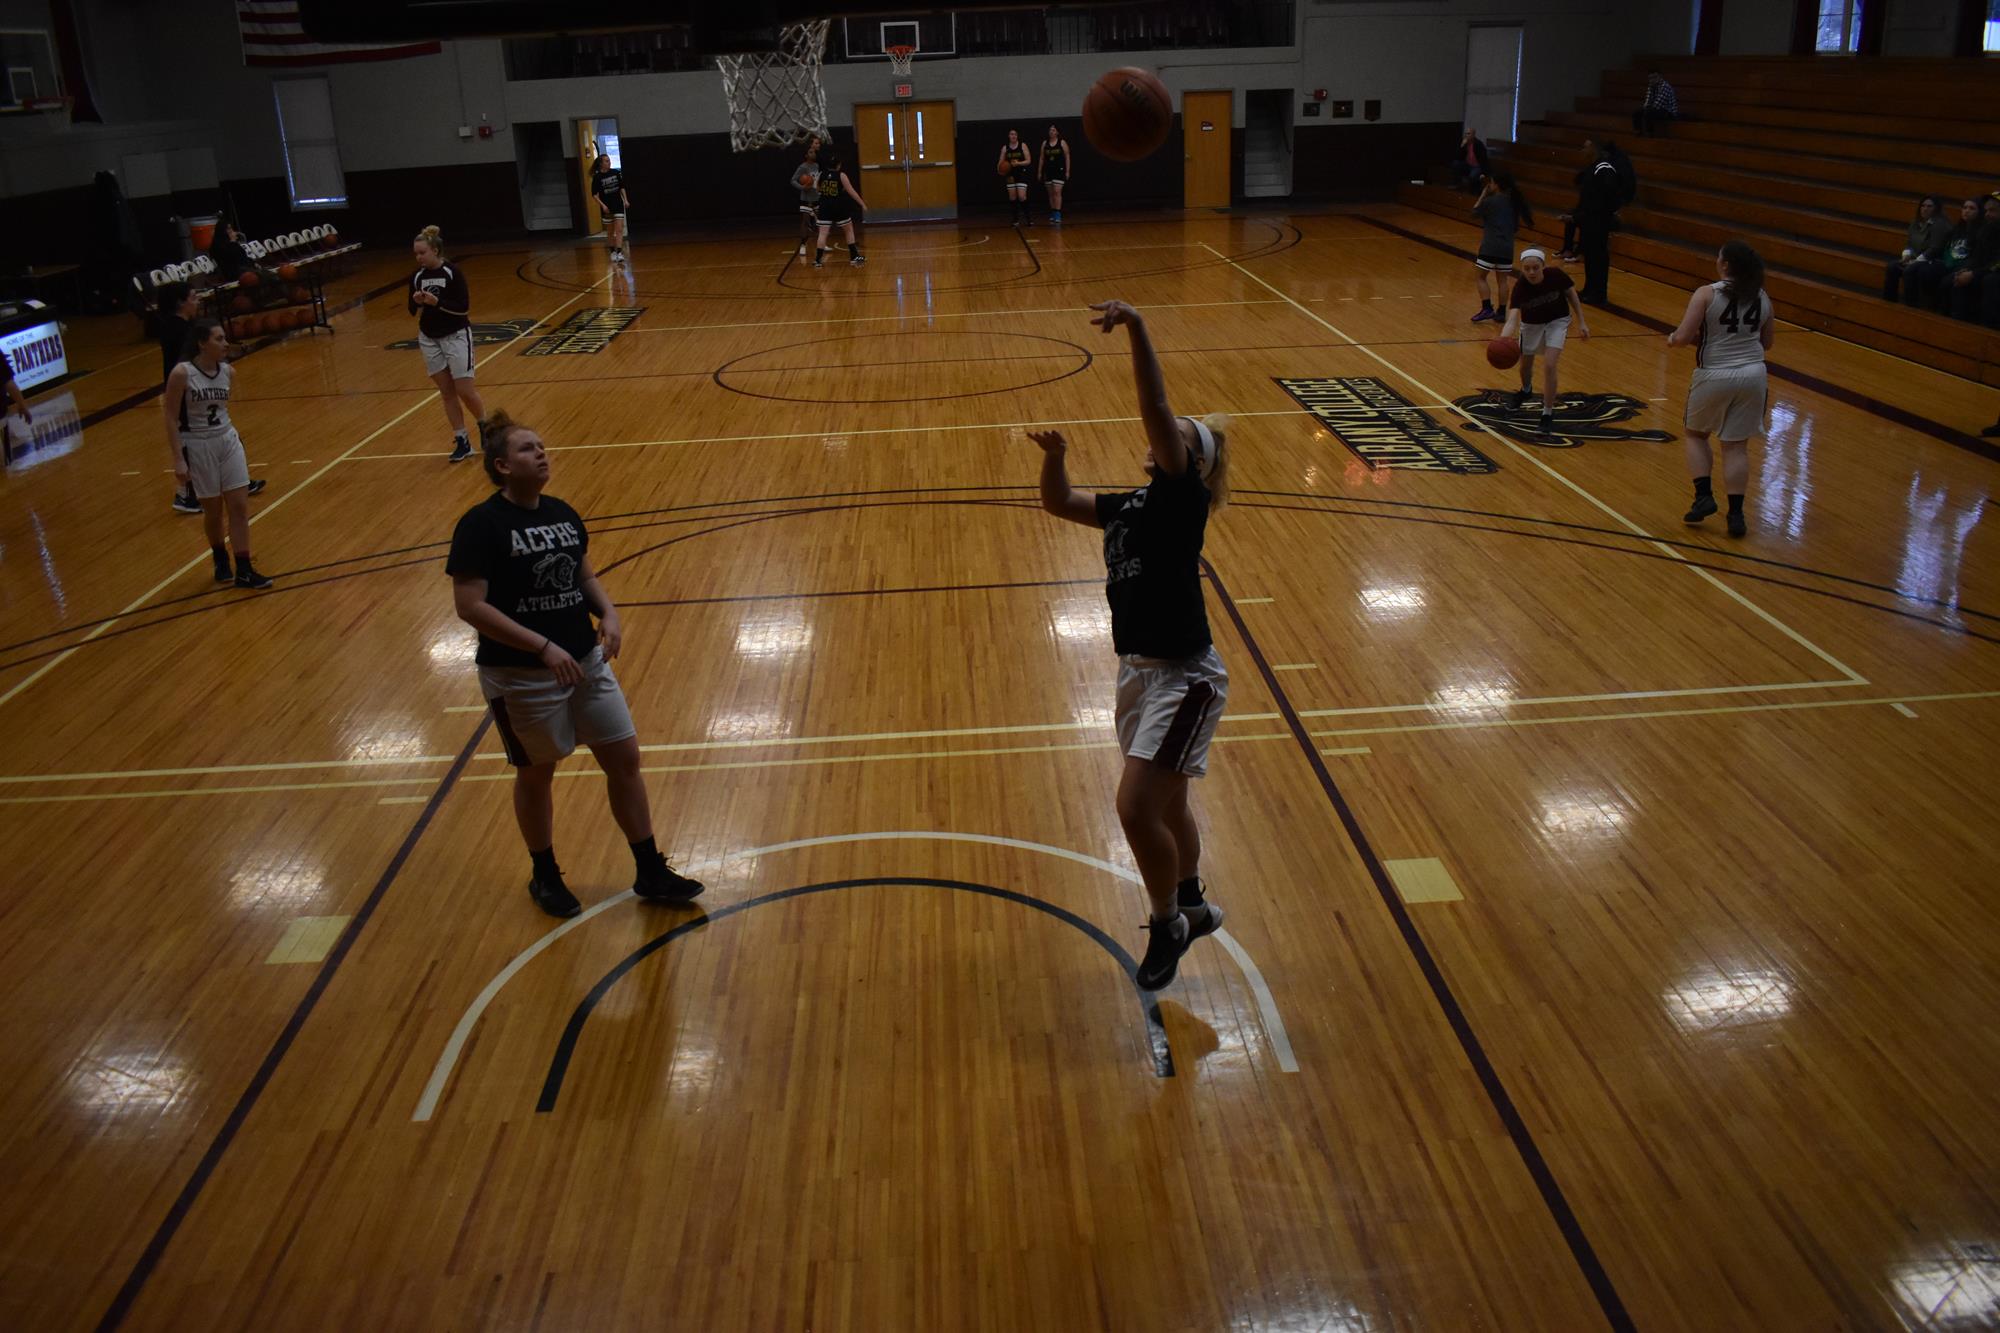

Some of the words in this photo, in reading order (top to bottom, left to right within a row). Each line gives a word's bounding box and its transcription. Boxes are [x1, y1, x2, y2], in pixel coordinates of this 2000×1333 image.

[1720, 299, 1761, 333] 44
[12, 334, 63, 374] PANTHERS
[207, 404, 221, 426] 2
[1278, 379, 1383, 417] COLLEGE
[1323, 419, 1449, 470] ALBANY
[510, 521, 580, 557] ACPHS
